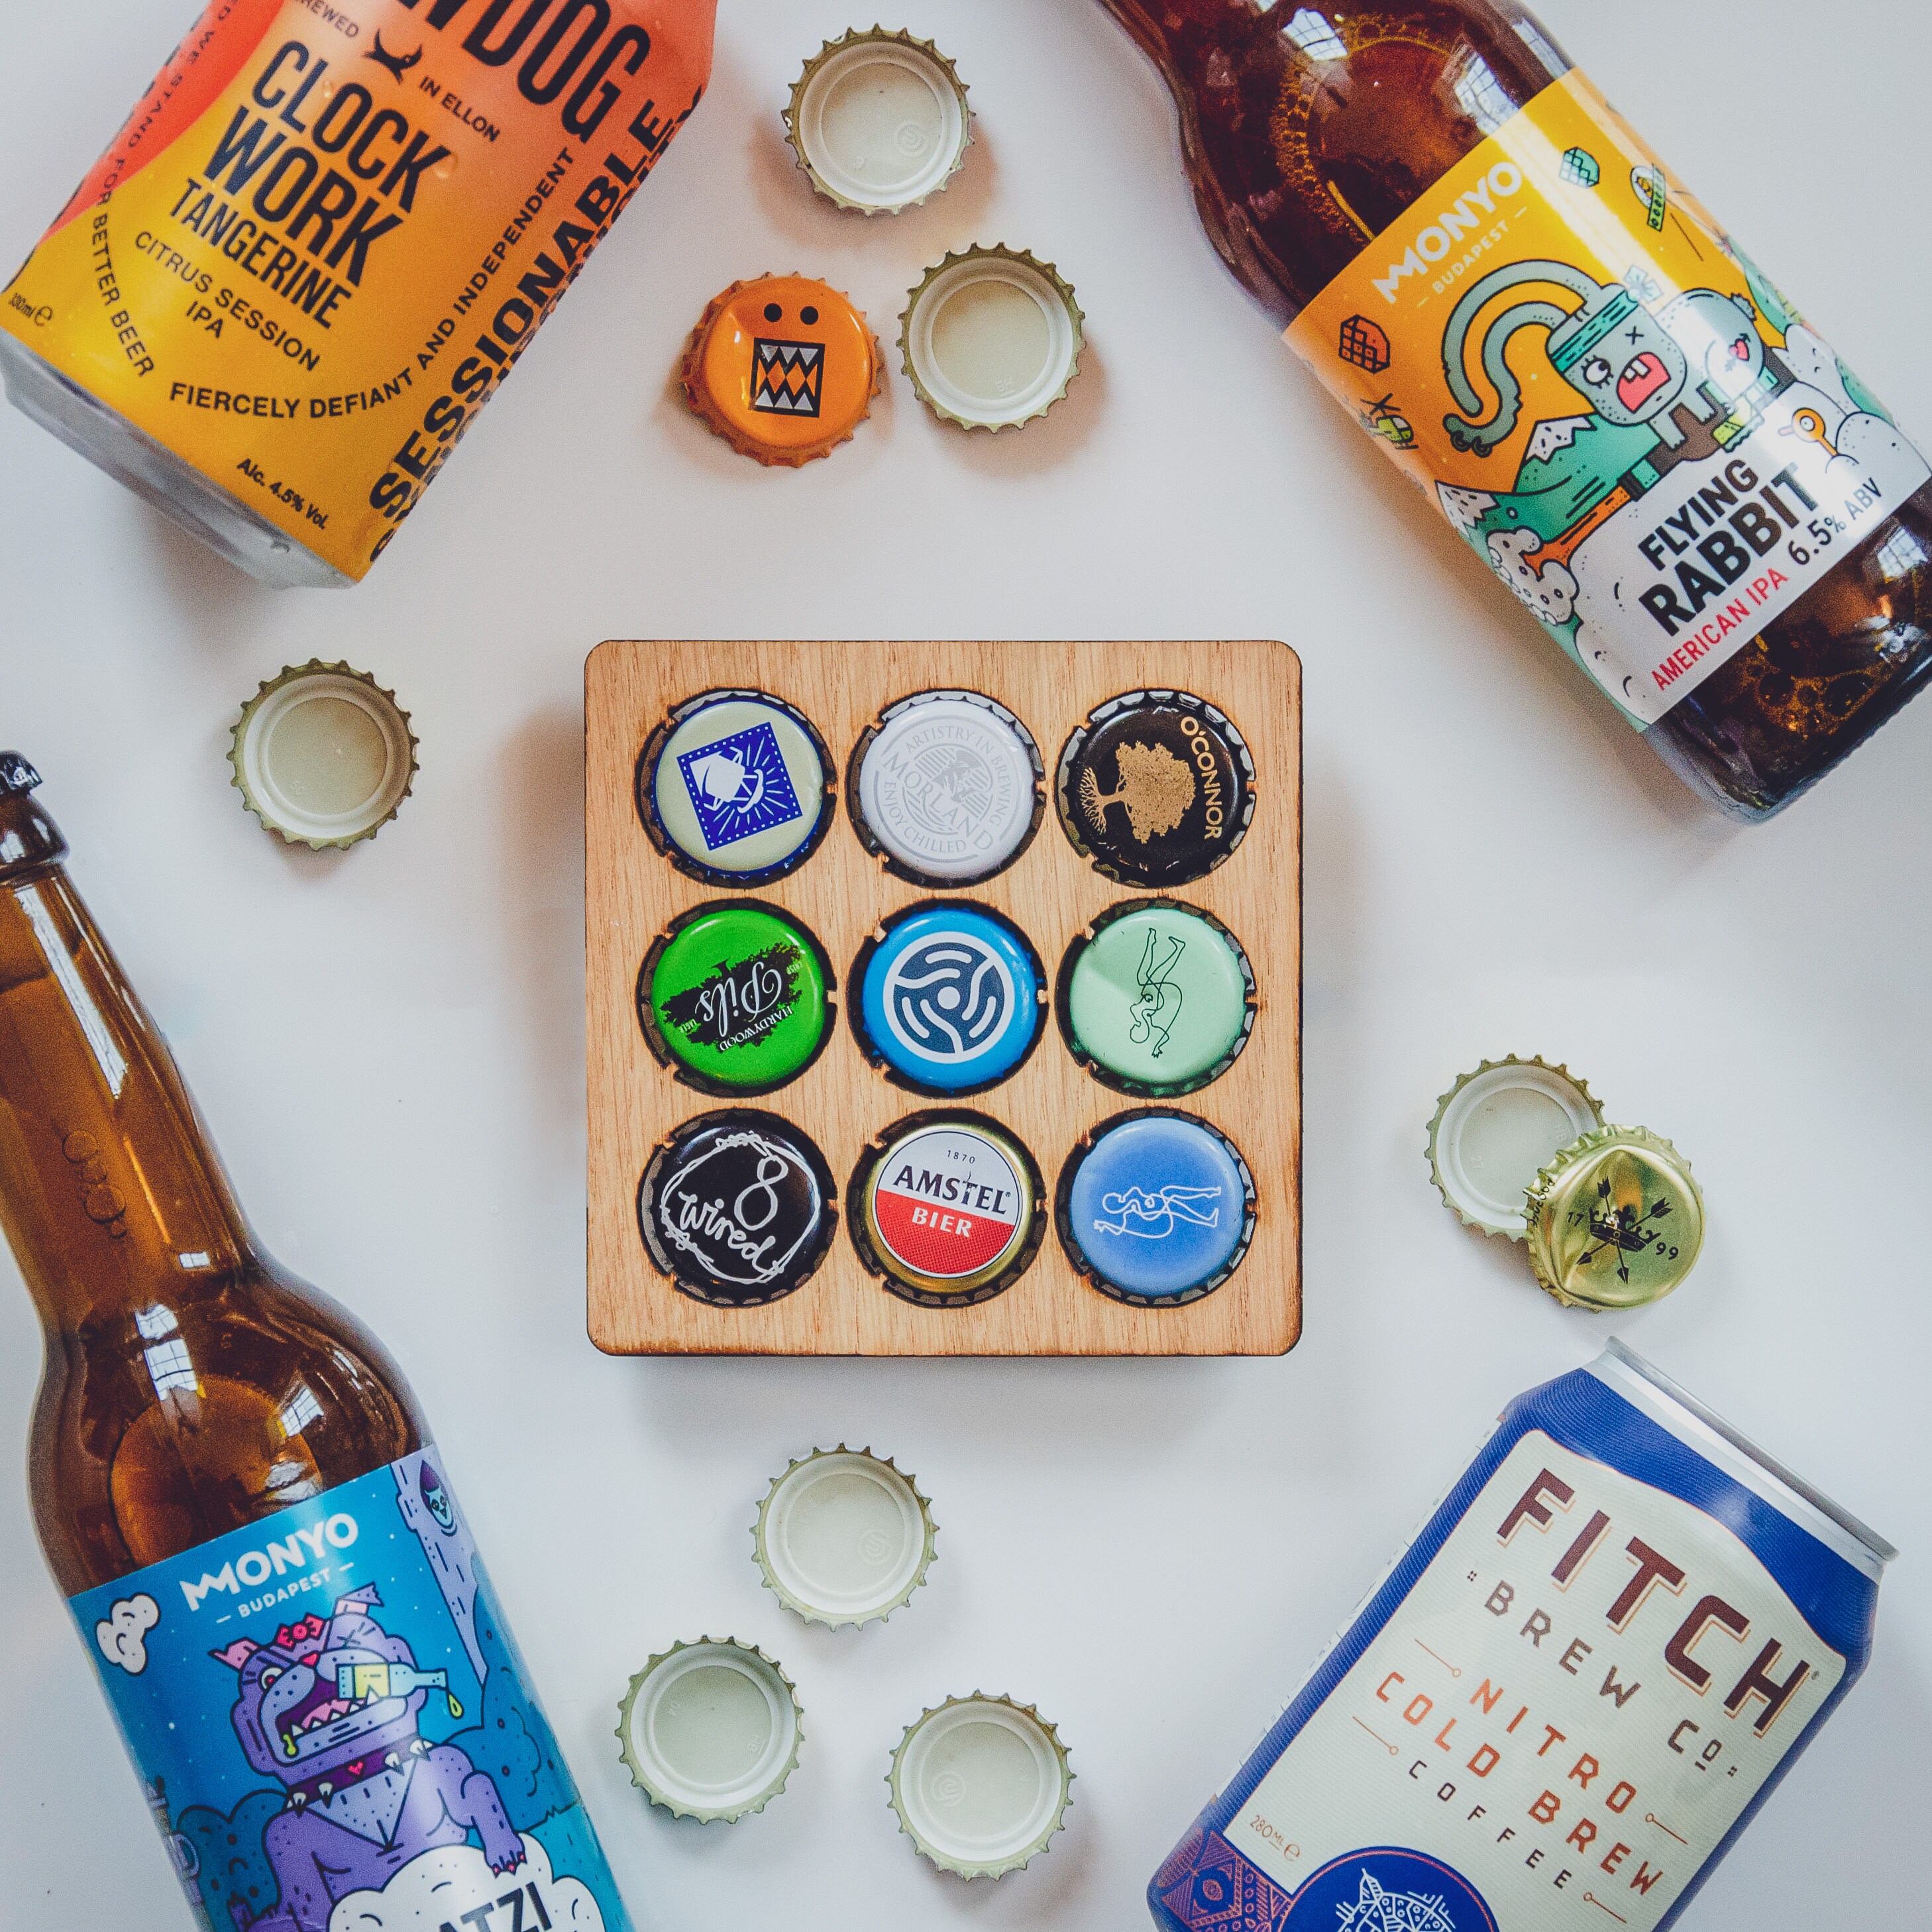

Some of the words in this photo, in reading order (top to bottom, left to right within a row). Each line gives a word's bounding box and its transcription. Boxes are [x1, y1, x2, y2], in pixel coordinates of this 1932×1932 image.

[129, 74, 183, 147] STAND
[298, 0, 359, 38] EWED
[419, 76, 441, 97] IN
[441, 92, 500, 142] ELLON
[396, 0, 651, 144] DOG
[252, 40, 452, 213] CLOCK
[96, 158, 125, 207] FOR
[203, 105, 403, 287] WORK
[1372, 162, 1522, 304] MONYO
[91, 211, 120, 305] BETTER
[135, 231, 213, 293] CITRUS
[215, 288, 321, 372] SESSION
[170, 178, 354, 329] TANGERINE
[170, 382, 299, 419] FIERCELY
[310, 367, 413, 419] DEFIANT
[416, 318, 456, 370] AND
[453, 147, 574, 315] INDEPENDENT
[1432, 220, 1509, 295] BUDAPEST
[111, 309, 154, 377] BEER
[186, 300, 224, 338] IPA
[369, 98, 672, 519] SESSIONABLE
[237, 458, 265, 486] Alc.
[269, 482, 304, 512] 4.5%
[305, 504, 329, 530] Vol
[1638, 459, 1760, 571] FLYING
[1638, 462, 1818, 637] RABBIT
[1651, 598, 1750, 691] AMERICAN
[1745, 567, 1790, 606] IPA
[1788, 515, 1847, 566] 6.5%
[1844, 476, 1884, 521] ABV
[882, 752, 994, 850] MORLAND
[883, 781, 908, 826] ENJOY
[903, 827, 967, 854] CHILLED
[905, 725, 975, 753] ARTISTRY
[975, 733, 994, 754] IN
[988, 754, 1012, 828] BREWING
[1180, 716, 1224, 840] O'CONNOR
[694, 961, 782, 1038] Pils
[719, 1004, 793, 1052] HARDYWOOD
[946, 1150, 976, 1164] 1870
[911, 1206, 973, 1238] BIER
[1567, 1211, 1585, 1227] 17
[1656, 1242, 1678, 1260] 99
[180, 1513, 359, 1612] MONYO
[238, 1568, 331, 1618] BUDAPEST
[1496, 1468, 1811, 1739] FITCH
[1484, 1580, 1642, 1709] BREW
[1376, 1671, 1501, 1778] COLD
[1527, 1790, 1664, 1896] BREW
[1469, 1678, 1637, 1814] NITRO
[1409, 1760, 1572, 1889] COFFEE
[439, 1881, 553, 1932] TZI
